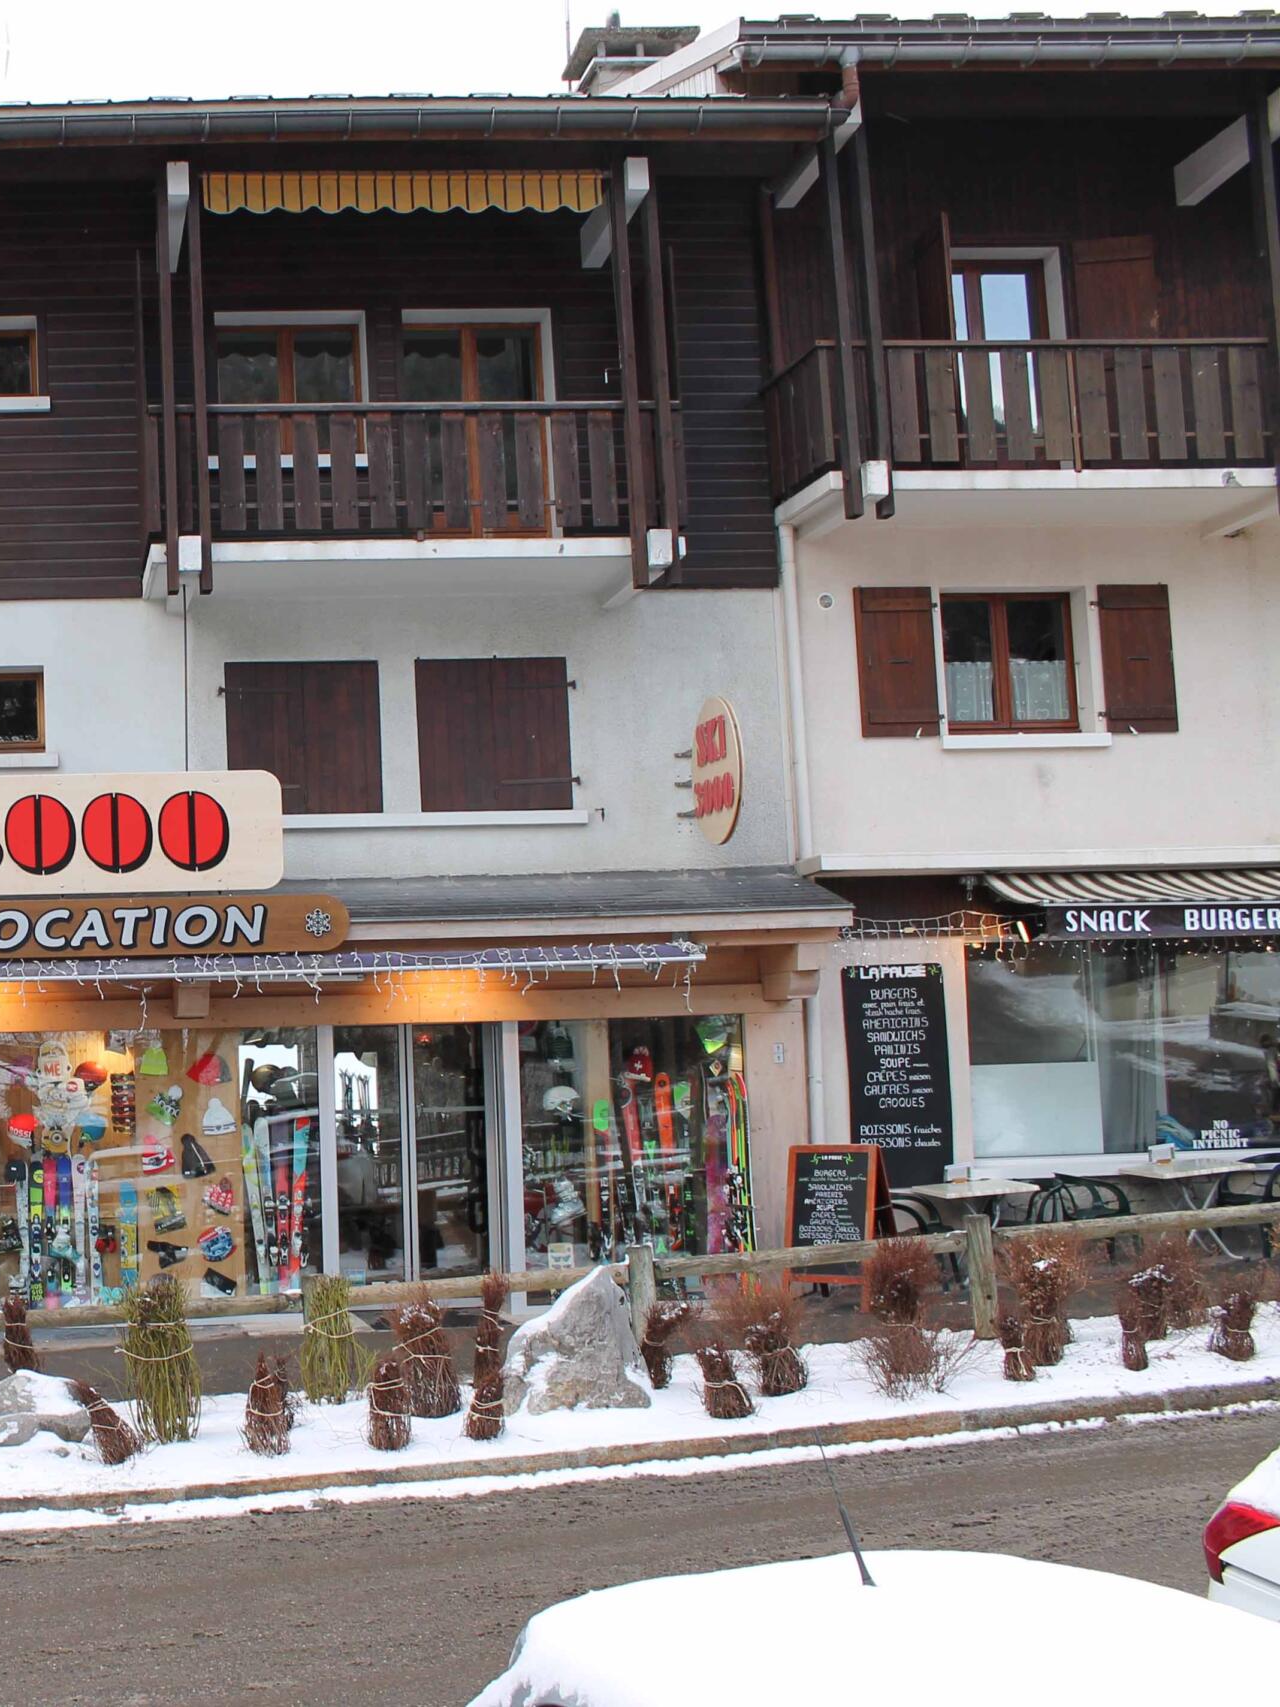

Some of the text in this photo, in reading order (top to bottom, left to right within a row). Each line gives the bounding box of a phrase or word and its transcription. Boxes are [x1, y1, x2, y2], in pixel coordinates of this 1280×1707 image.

[695, 714, 727, 767] SKI
[694, 772, 735, 819] 3000
[1065, 909, 1152, 933] SNACK
[860, 965, 927, 982] LA PAUSE
[870, 988, 918, 1000] BURGERS
[866, 1030, 926, 1043] SANDWICHS
[874, 1043, 921, 1055] PANINIS
[880, 1057, 911, 1069] SOUPE
[864, 1083, 910, 1096] GAUFRES
[879, 1096, 926, 1108] CROQUES
[860, 1123, 912, 1136] BOISSONS
[1212, 1119, 1228, 1130] NO
[1201, 1129, 1241, 1139] PICNIC
[1192, 1138, 1249, 1149] INTERDIT
